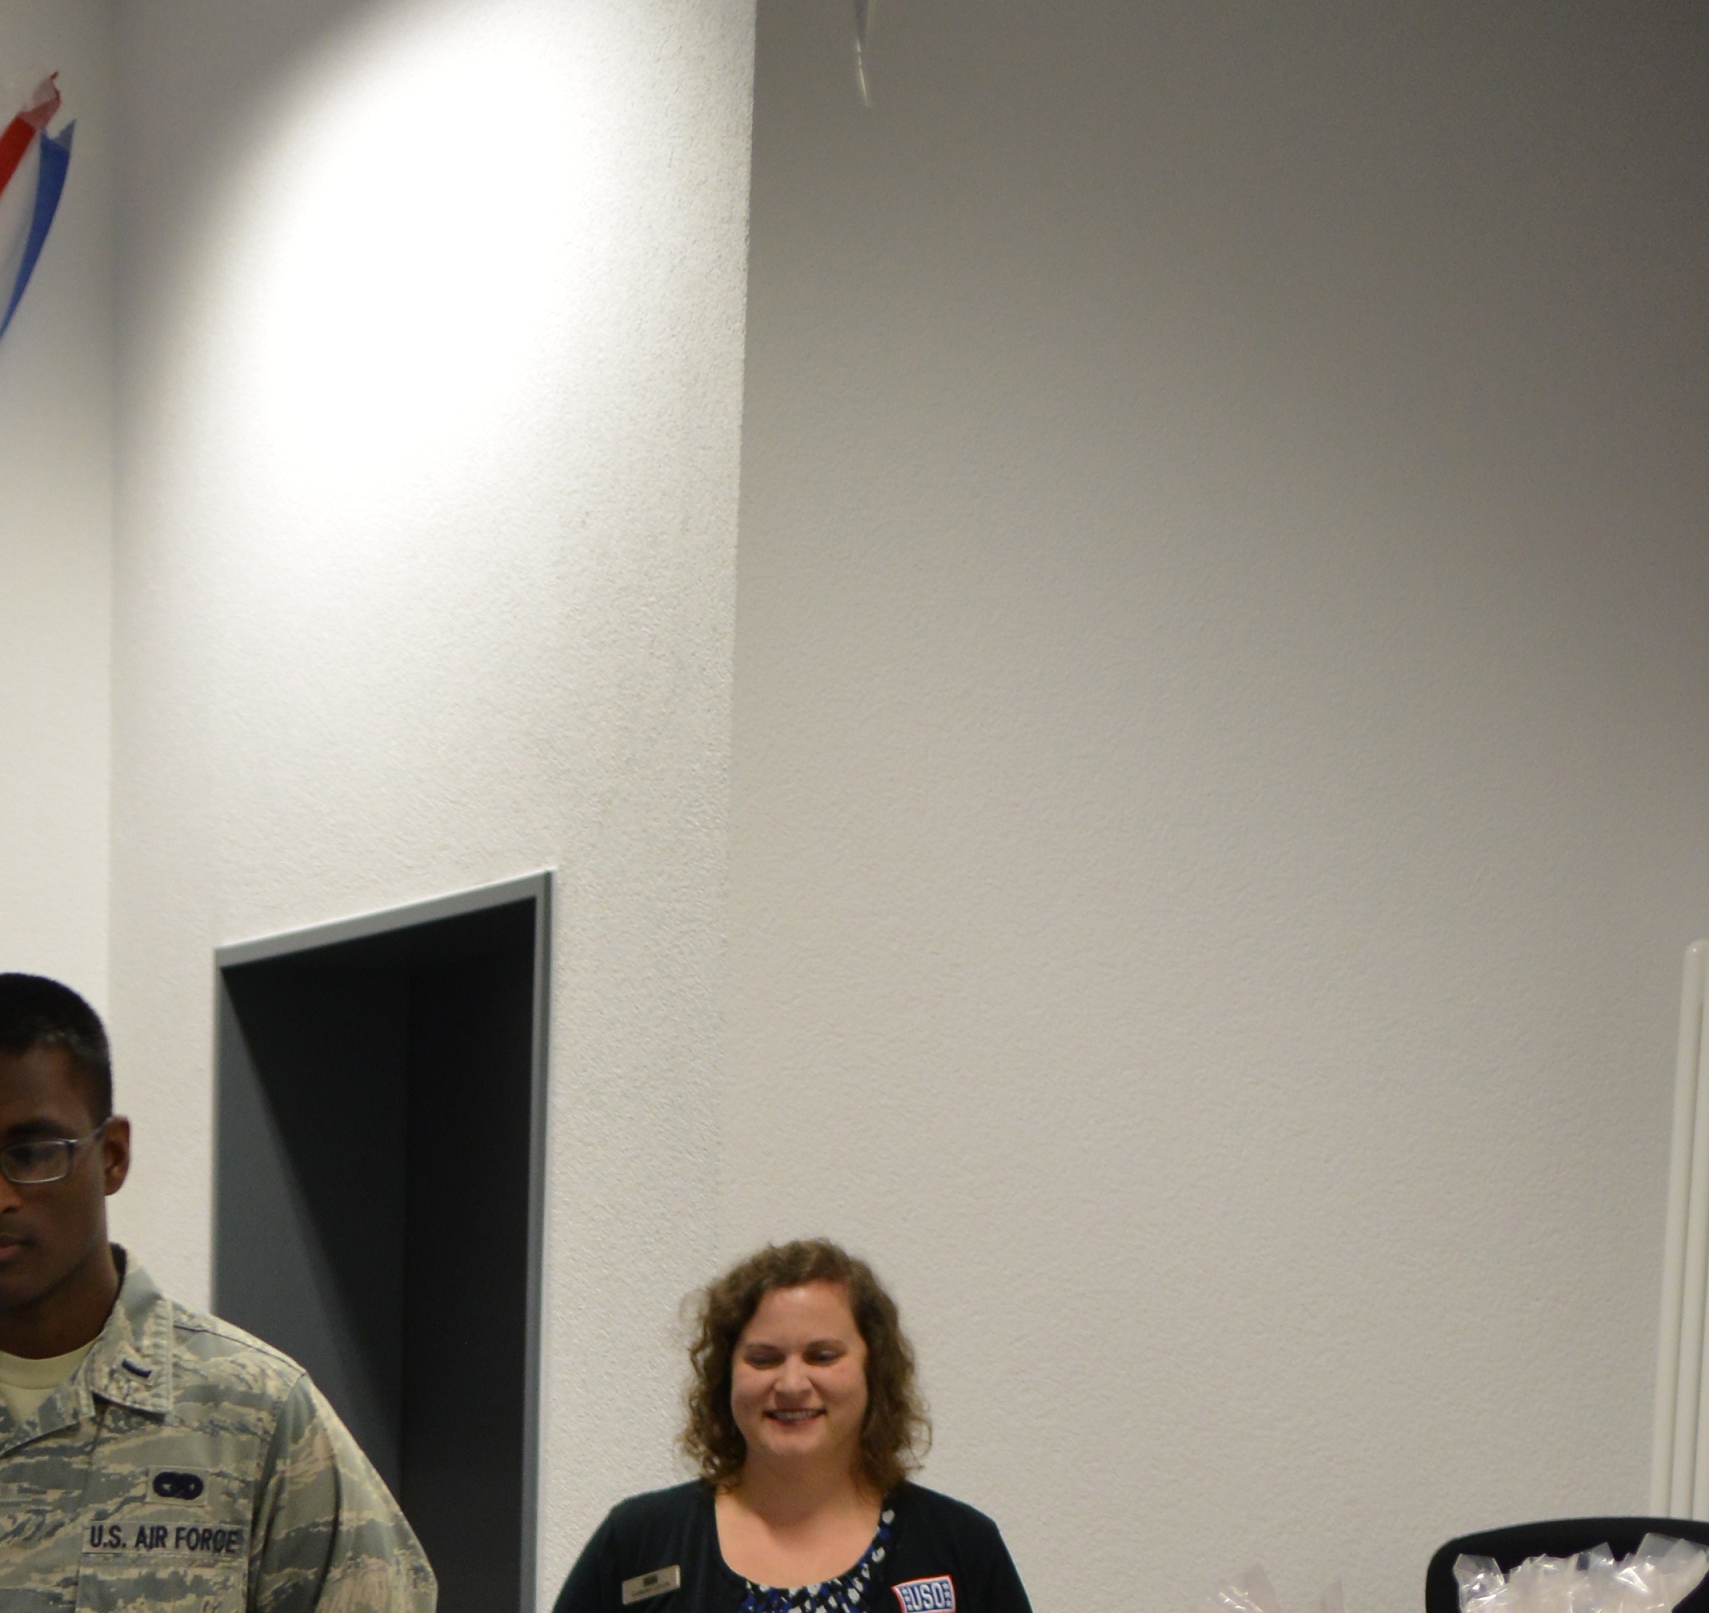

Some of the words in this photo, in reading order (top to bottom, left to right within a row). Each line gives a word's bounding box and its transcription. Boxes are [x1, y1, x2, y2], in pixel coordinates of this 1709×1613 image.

[90, 1524, 127, 1549] U.S.
[134, 1525, 169, 1550] AIR
[175, 1527, 242, 1554] FORCE
[908, 1582, 946, 1611] USO
